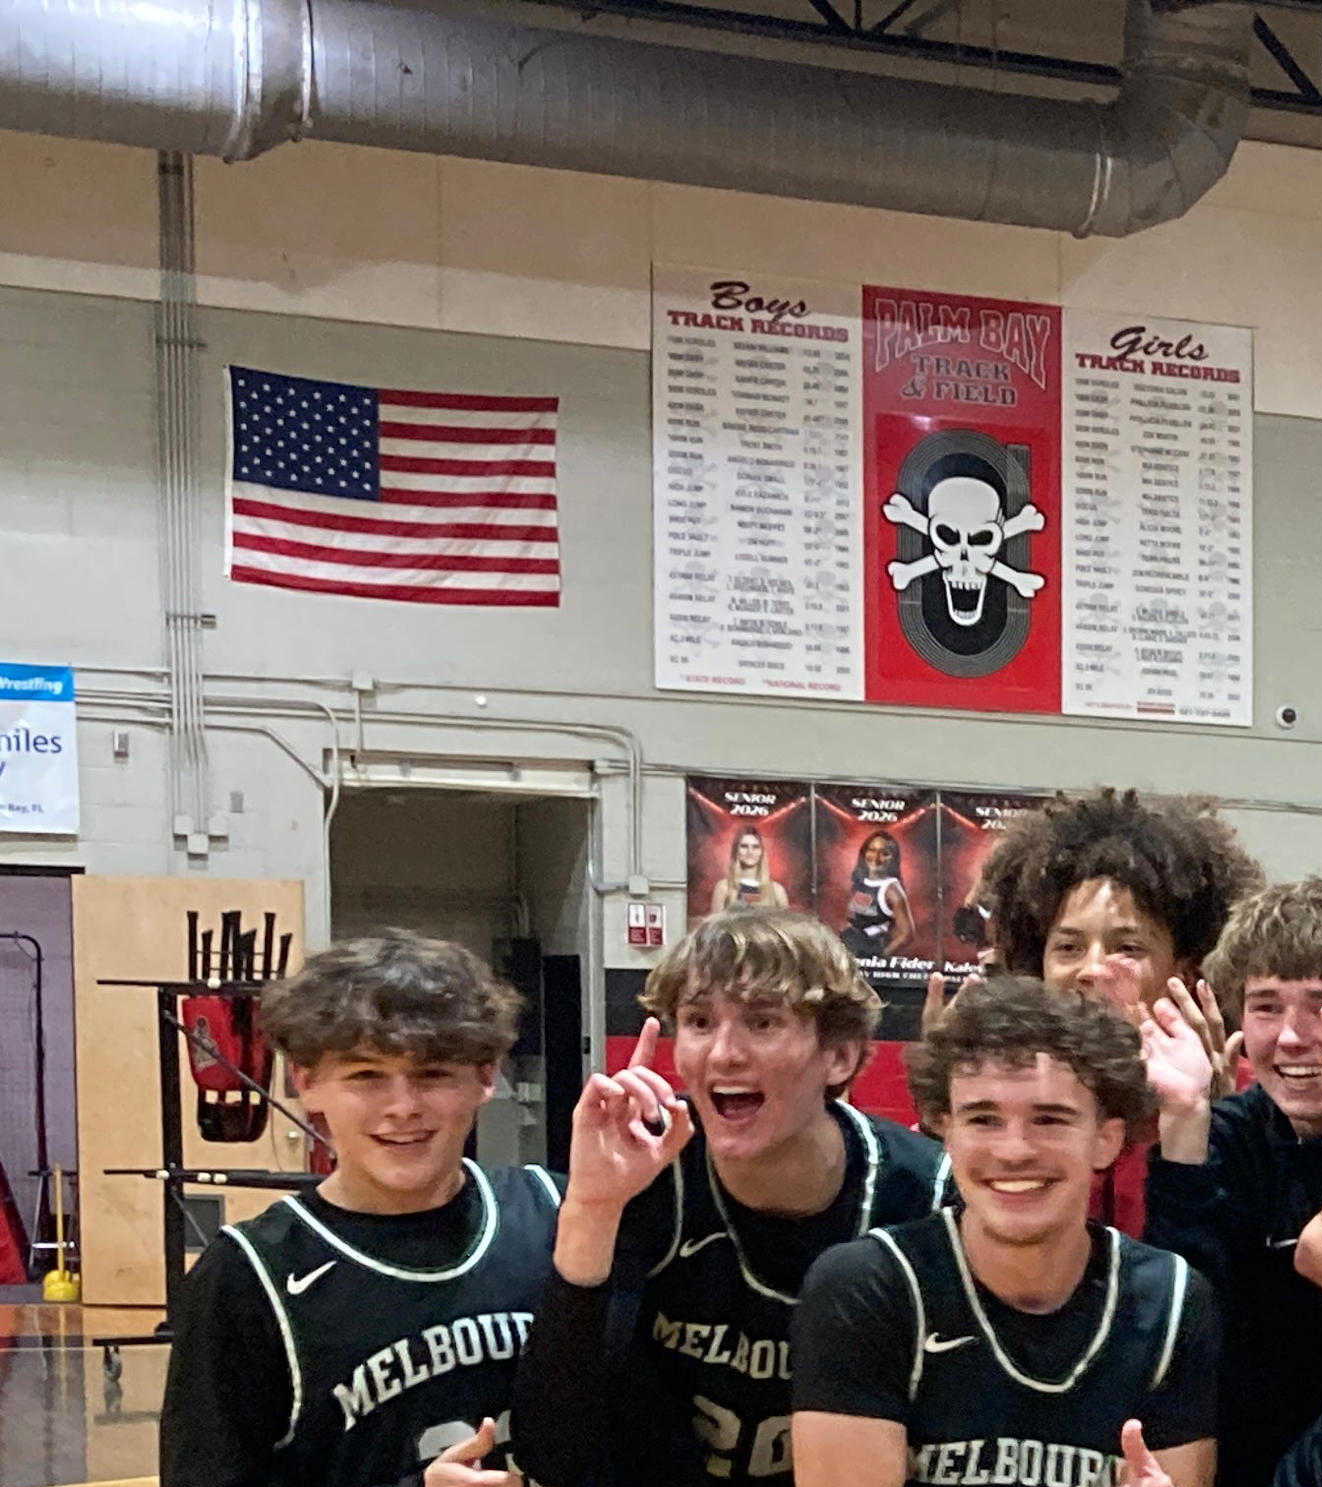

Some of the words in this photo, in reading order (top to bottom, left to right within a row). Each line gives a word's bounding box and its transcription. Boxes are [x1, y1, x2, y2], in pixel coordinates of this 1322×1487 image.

[709, 280, 811, 323] Boys
[667, 310, 744, 333] TRACK
[750, 319, 849, 343] RECORDS
[875, 298, 970, 373] PALM
[980, 310, 1050, 390] BAY
[1109, 325, 1209, 361] Girls
[912, 353, 1011, 382] TRACK
[1074, 353, 1145, 373] TRACK
[1150, 362, 1240, 384] RECORDS
[901, 377, 926, 400] &
[935, 381, 1017, 406] FIELD
[724, 791, 776, 805] SENIOR
[730, 804, 769, 817] 2026
[851, 798, 905, 811] SENIOR
[857, 810, 898, 823] 2026
[889, 956, 936, 971] Fider
